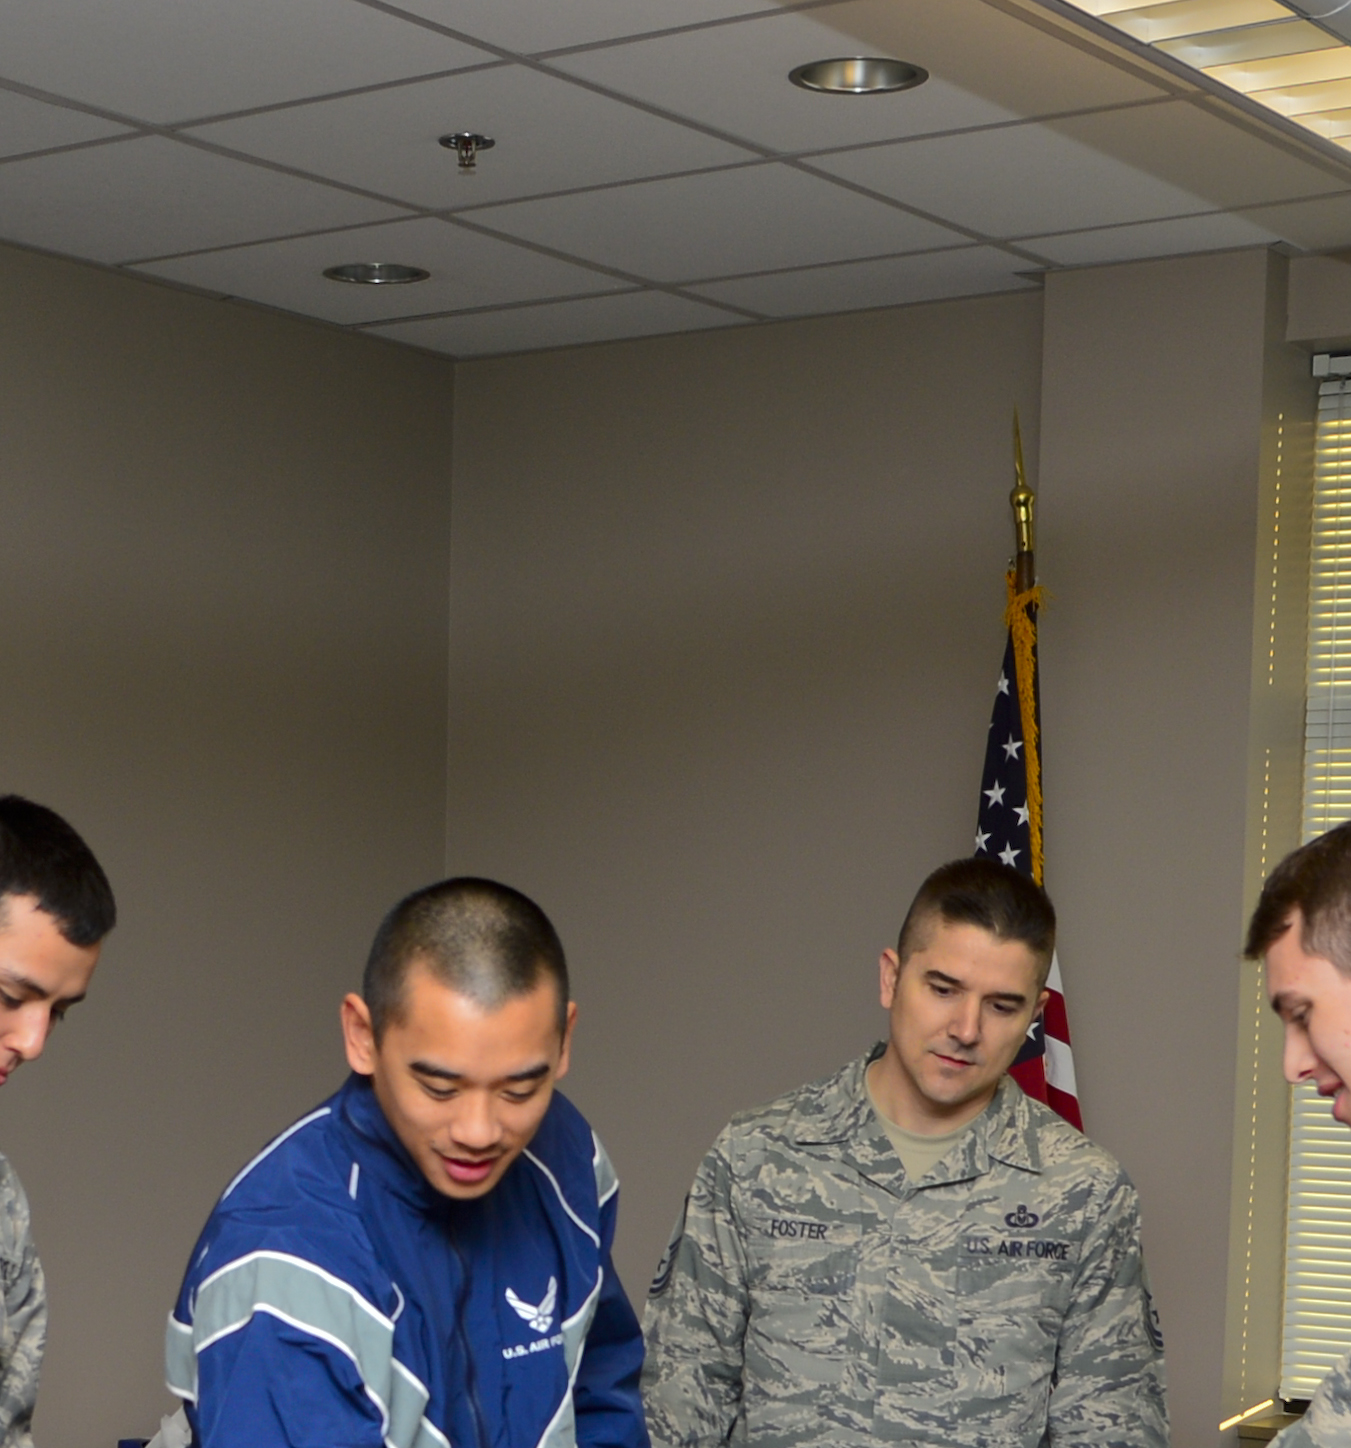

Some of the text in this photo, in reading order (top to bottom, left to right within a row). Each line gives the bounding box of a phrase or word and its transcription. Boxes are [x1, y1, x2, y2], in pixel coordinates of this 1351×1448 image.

[770, 1218, 828, 1240] FOSTER
[997, 1239, 1023, 1258] AIR
[1026, 1240, 1070, 1261] FORCE
[529, 1338, 551, 1353] AIR
